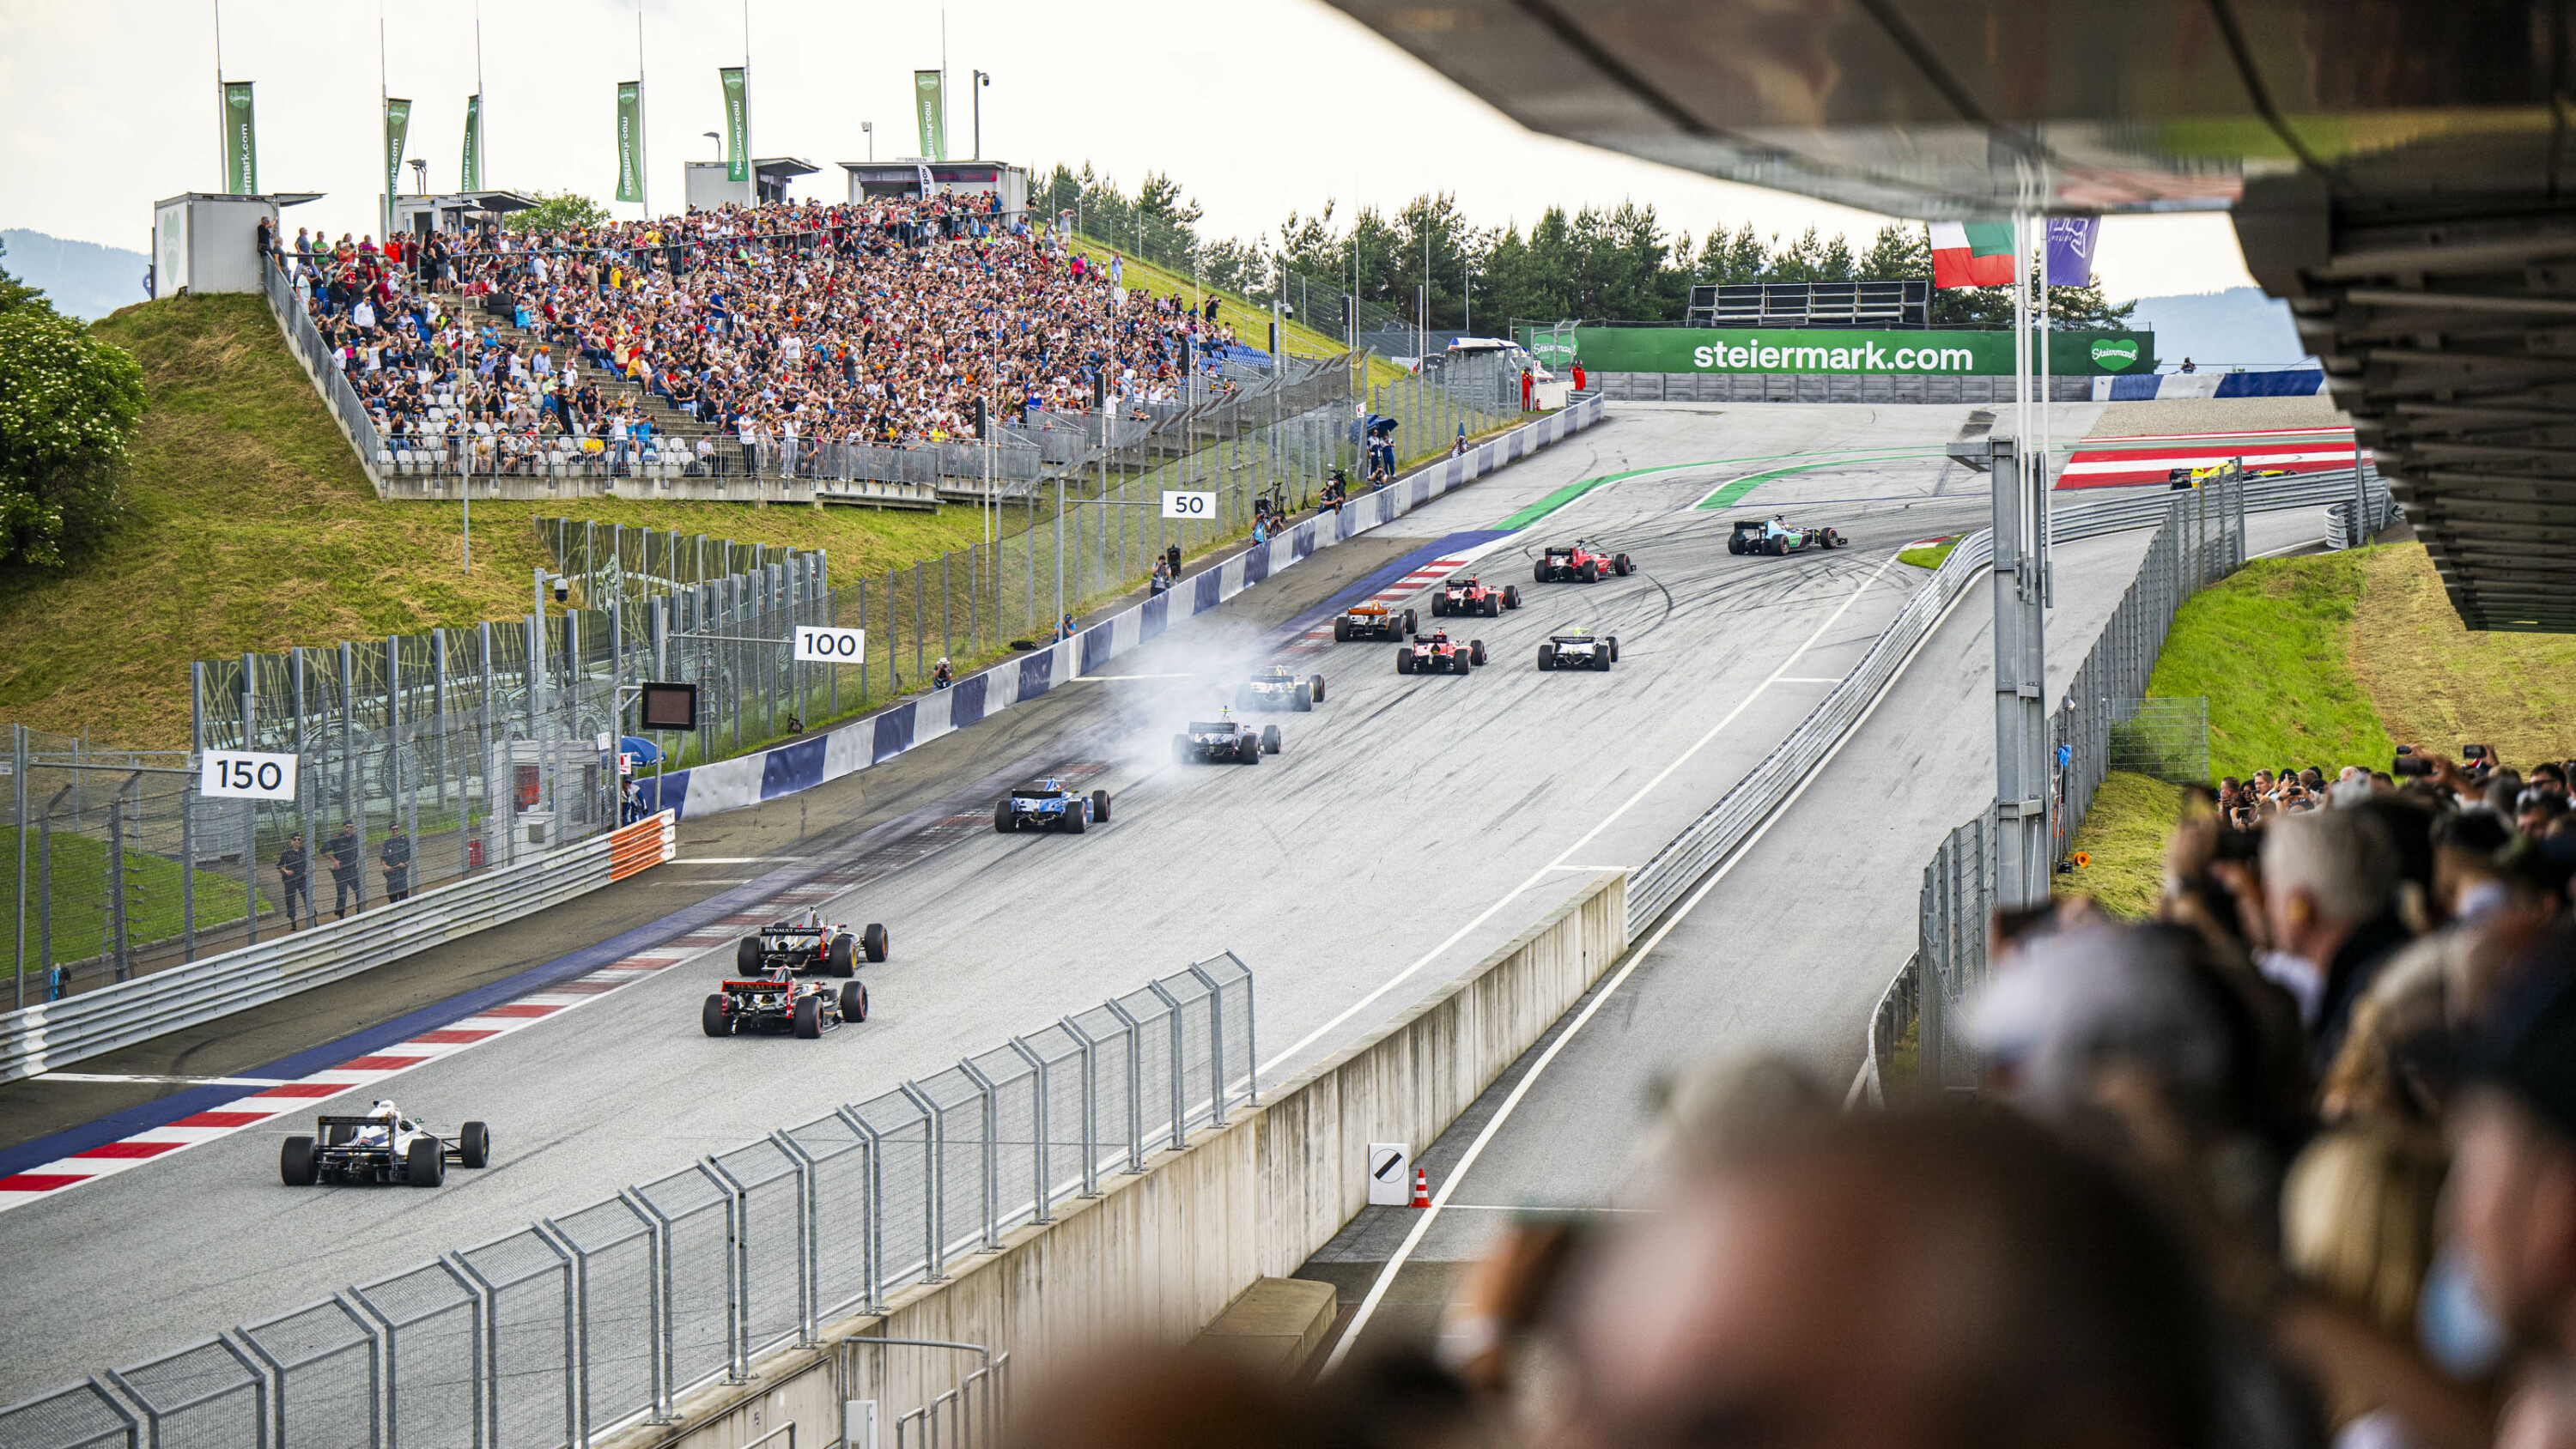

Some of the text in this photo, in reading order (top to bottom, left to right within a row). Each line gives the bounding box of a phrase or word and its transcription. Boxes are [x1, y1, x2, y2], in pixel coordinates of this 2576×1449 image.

[241, 124, 252, 194] ermark.com
[1693, 339, 1973, 370] steiermark.com
[2092, 348, 2136, 361] Steiermark
[1176, 496, 1204, 513] 50
[805, 633, 856, 656] 100
[216, 760, 283, 791] 150
